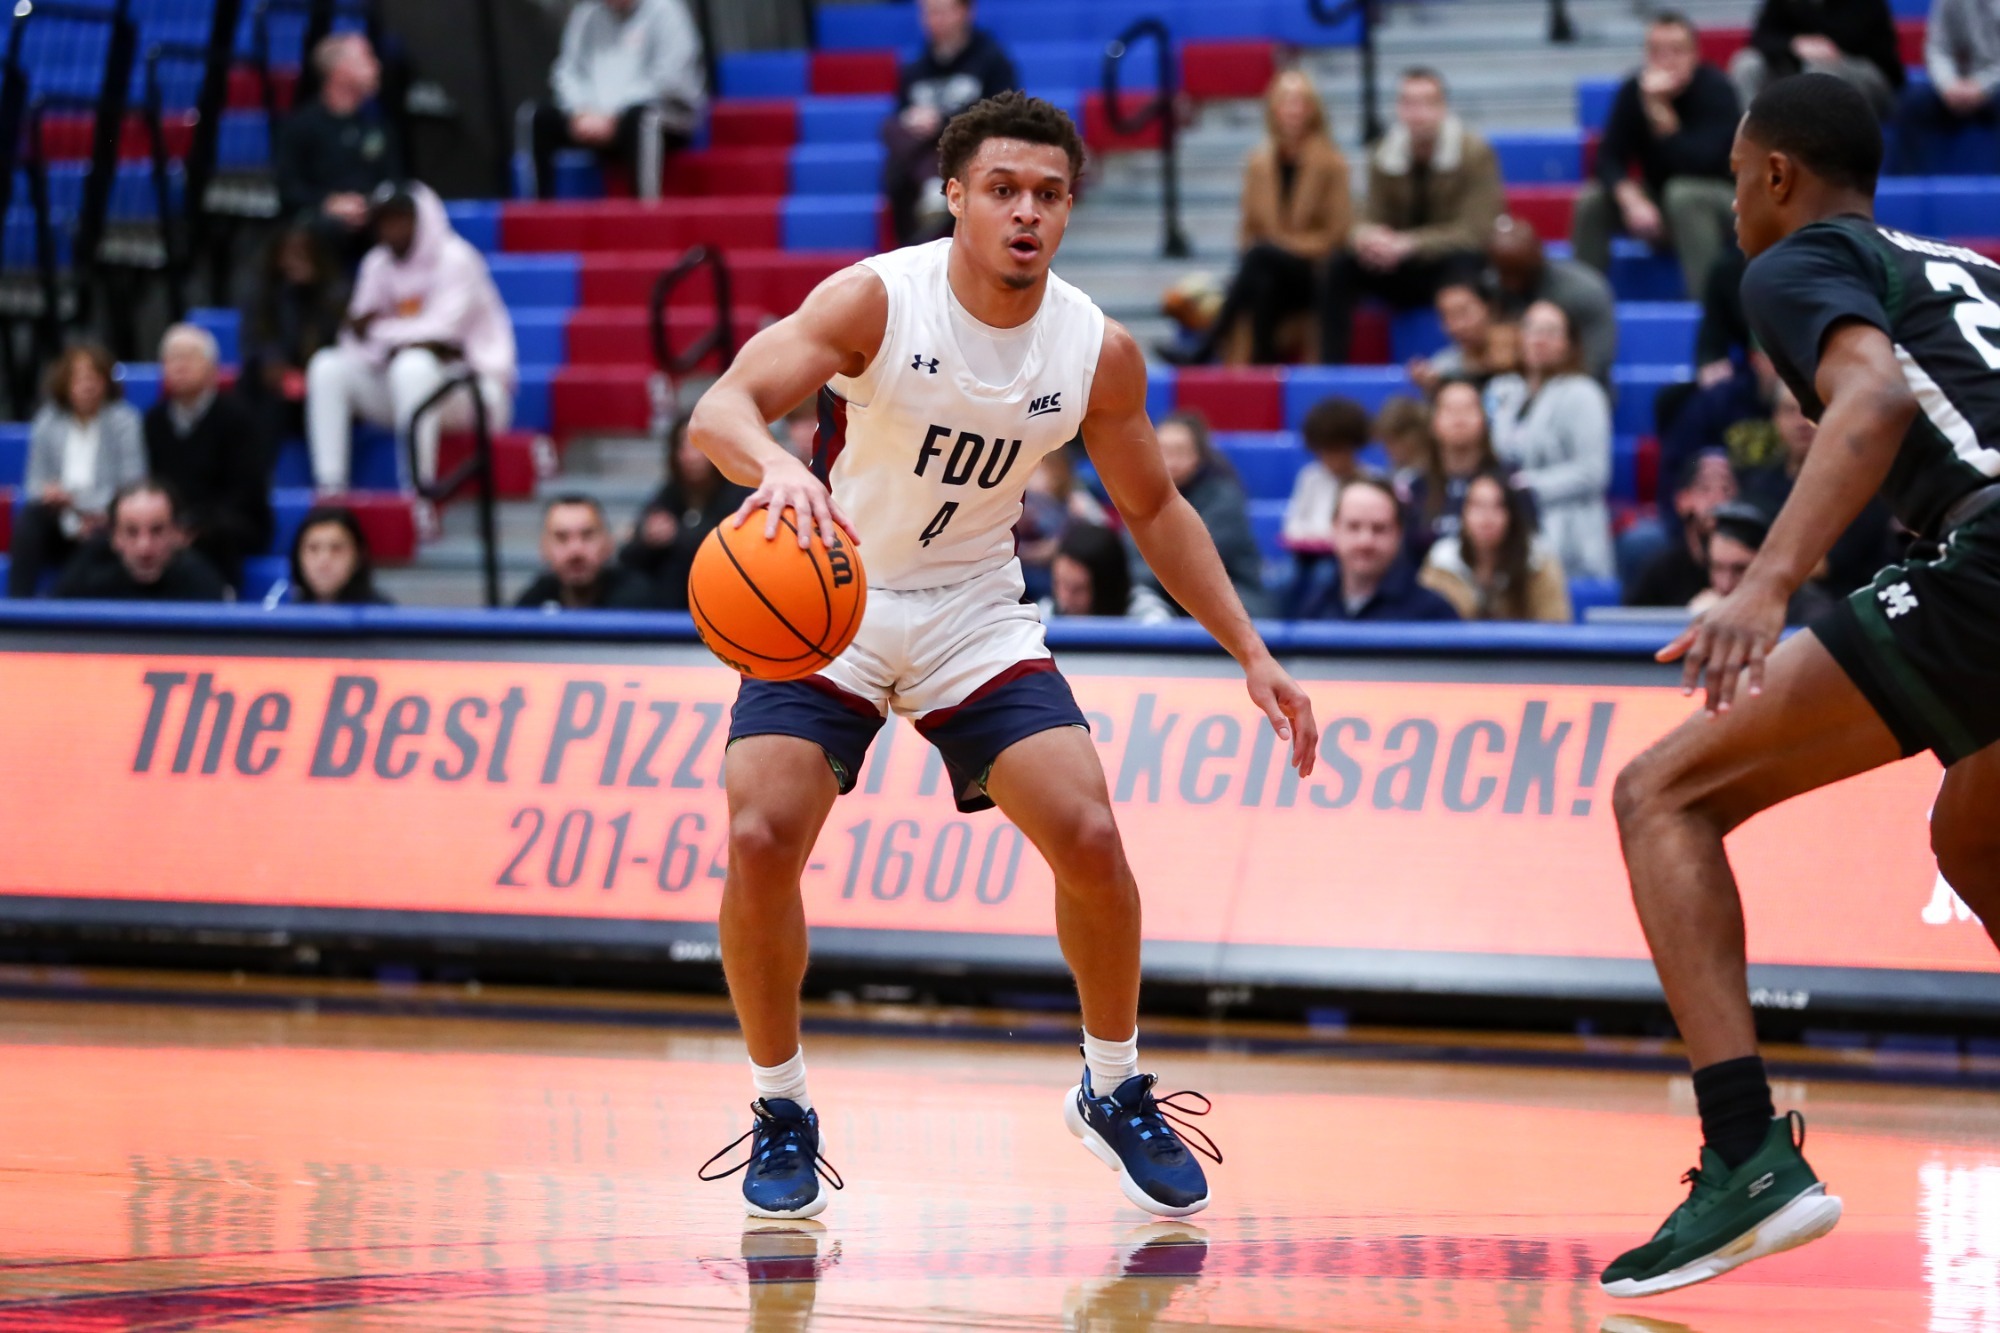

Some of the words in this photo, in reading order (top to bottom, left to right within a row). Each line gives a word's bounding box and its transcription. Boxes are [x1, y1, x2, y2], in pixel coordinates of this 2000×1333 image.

[1027, 391, 1062, 414] NEC
[913, 423, 1022, 489] FDU
[918, 501, 960, 548] 4
[131, 670, 290, 776] The
[309, 674, 525, 784] Best
[541, 680, 728, 790] Pizz
